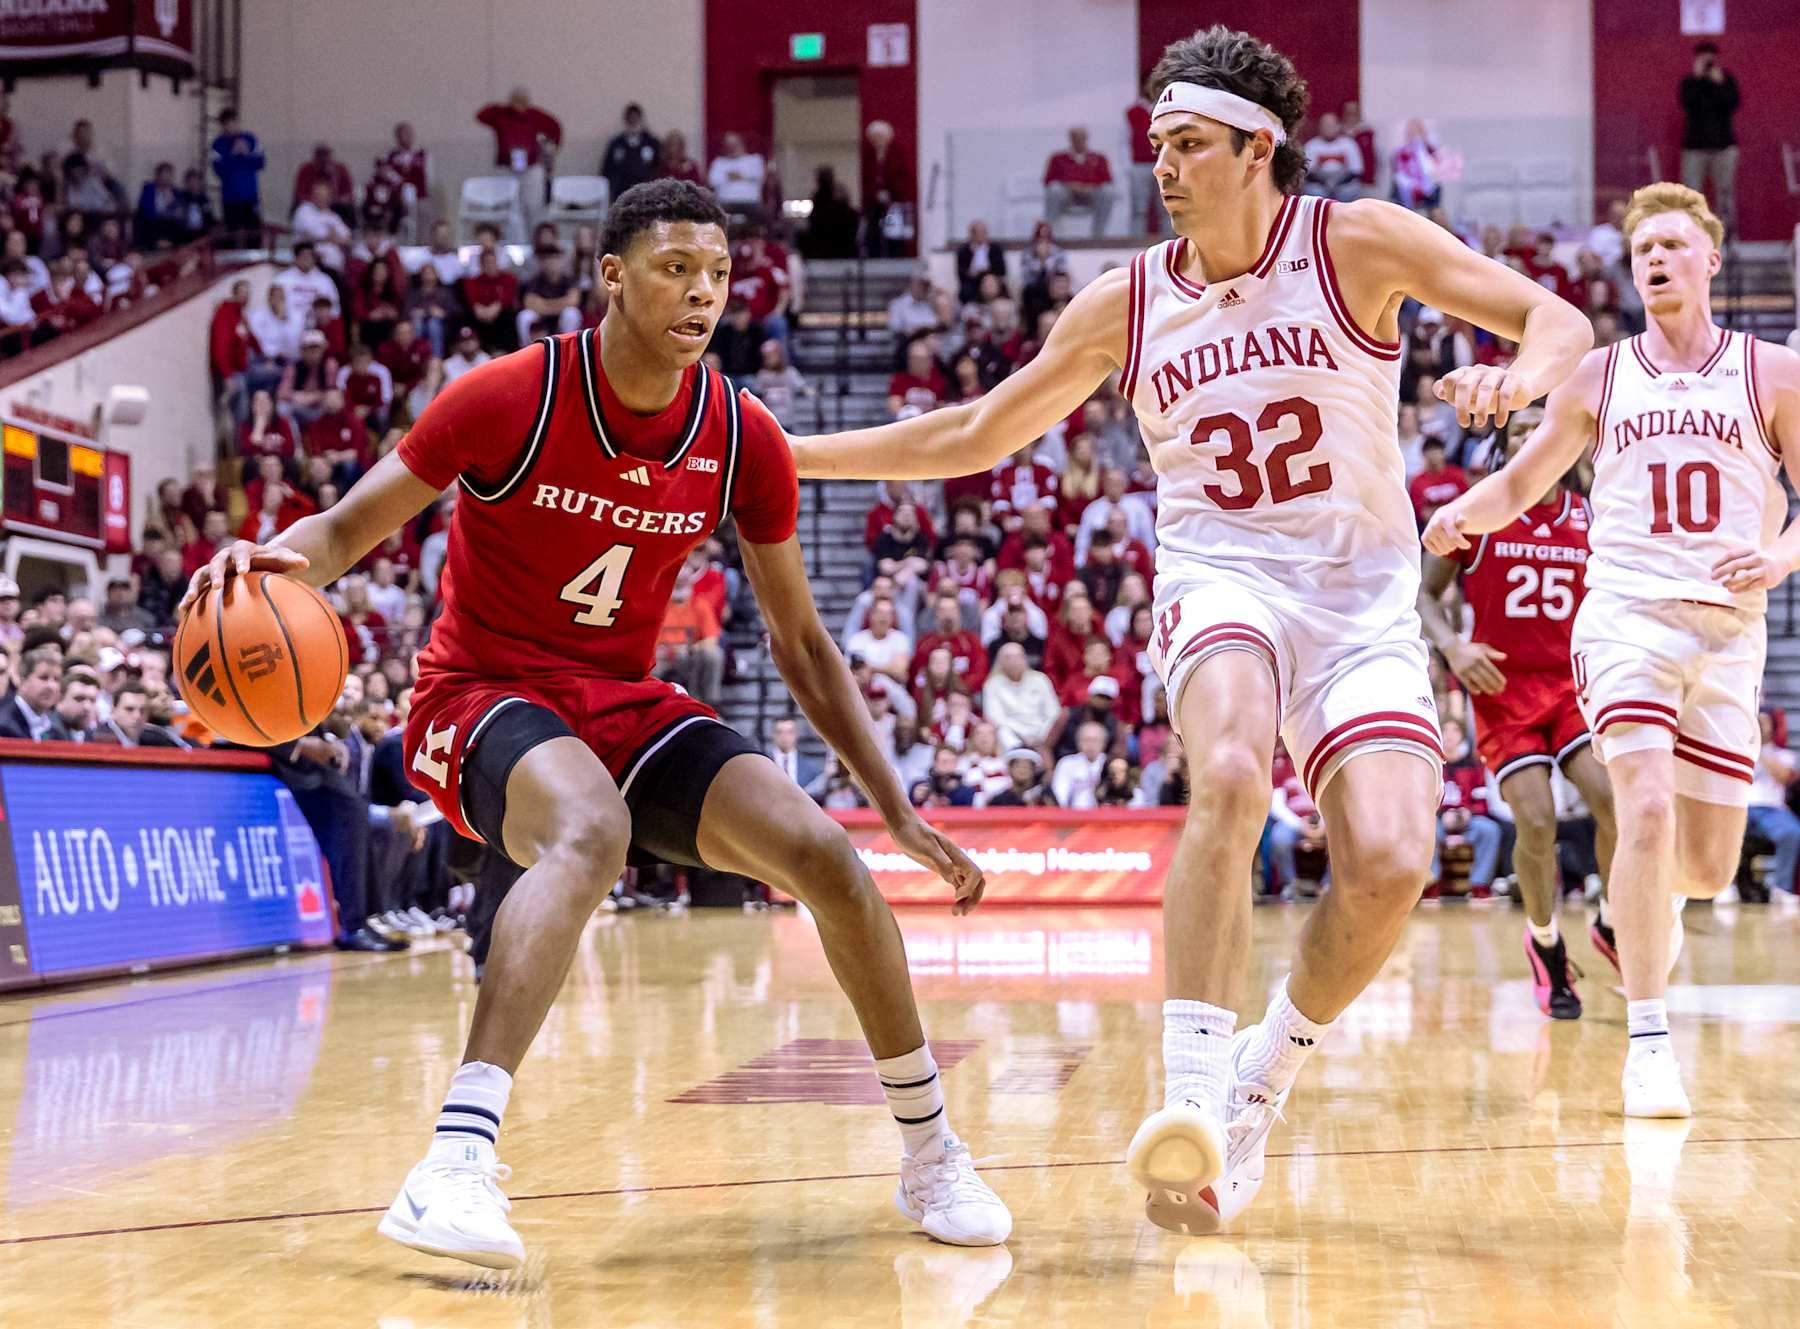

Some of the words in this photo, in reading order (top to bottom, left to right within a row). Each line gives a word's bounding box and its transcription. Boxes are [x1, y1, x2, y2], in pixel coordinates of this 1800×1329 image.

[1151, 327, 1339, 414] INDIANA
[1190, 396, 1333, 510] 32
[1614, 409, 1743, 455] INDIANA
[532, 483, 706, 535] RUTGERS
[1647, 461, 1721, 535] 10
[1494, 541, 1588, 564] RUTGERS
[559, 543, 635, 628] 4
[1504, 564, 1576, 621] 25
[33, 827, 120, 916] AUTO
[139, 827, 226, 907] HOME
[237, 826, 289, 898] LIFE
[1046, 847, 1152, 871] Hoosiers
